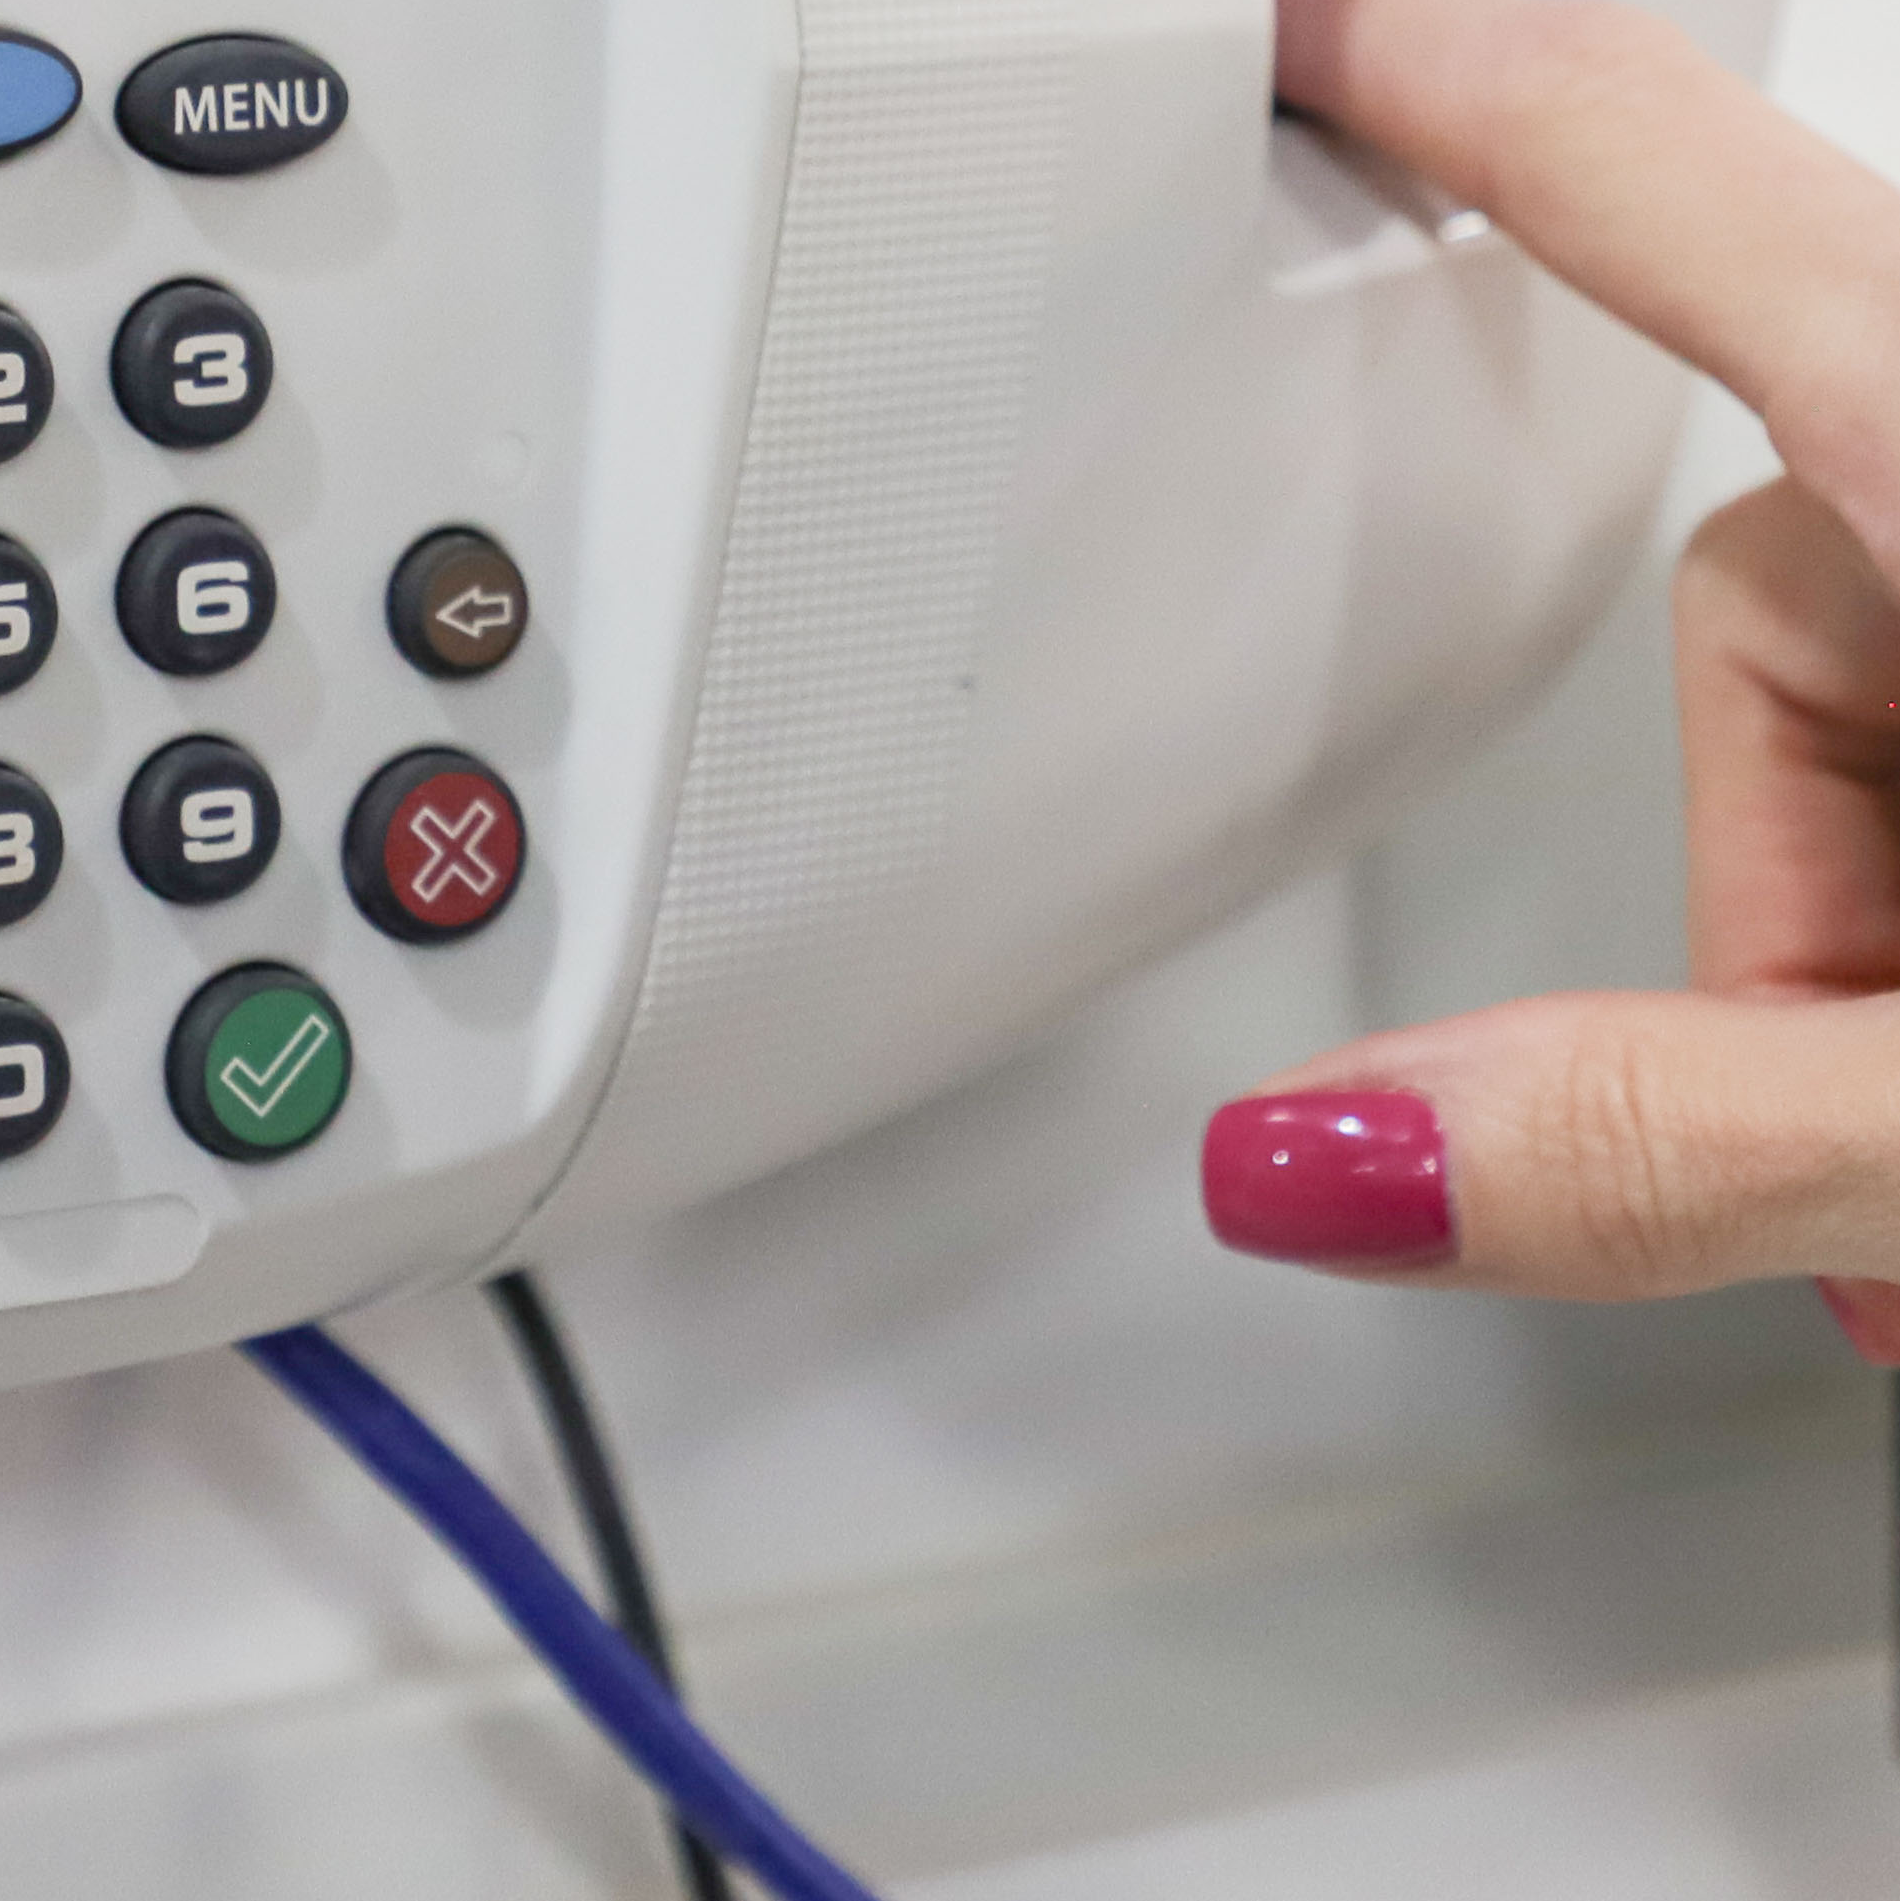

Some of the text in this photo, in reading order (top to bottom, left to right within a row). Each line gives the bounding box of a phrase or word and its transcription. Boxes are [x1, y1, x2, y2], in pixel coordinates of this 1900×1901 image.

[173, 77, 330, 136] MENU
[173, 332, 248, 407] 3
[176, 560, 250, 634] 6
[180, 788, 254, 863] 9
